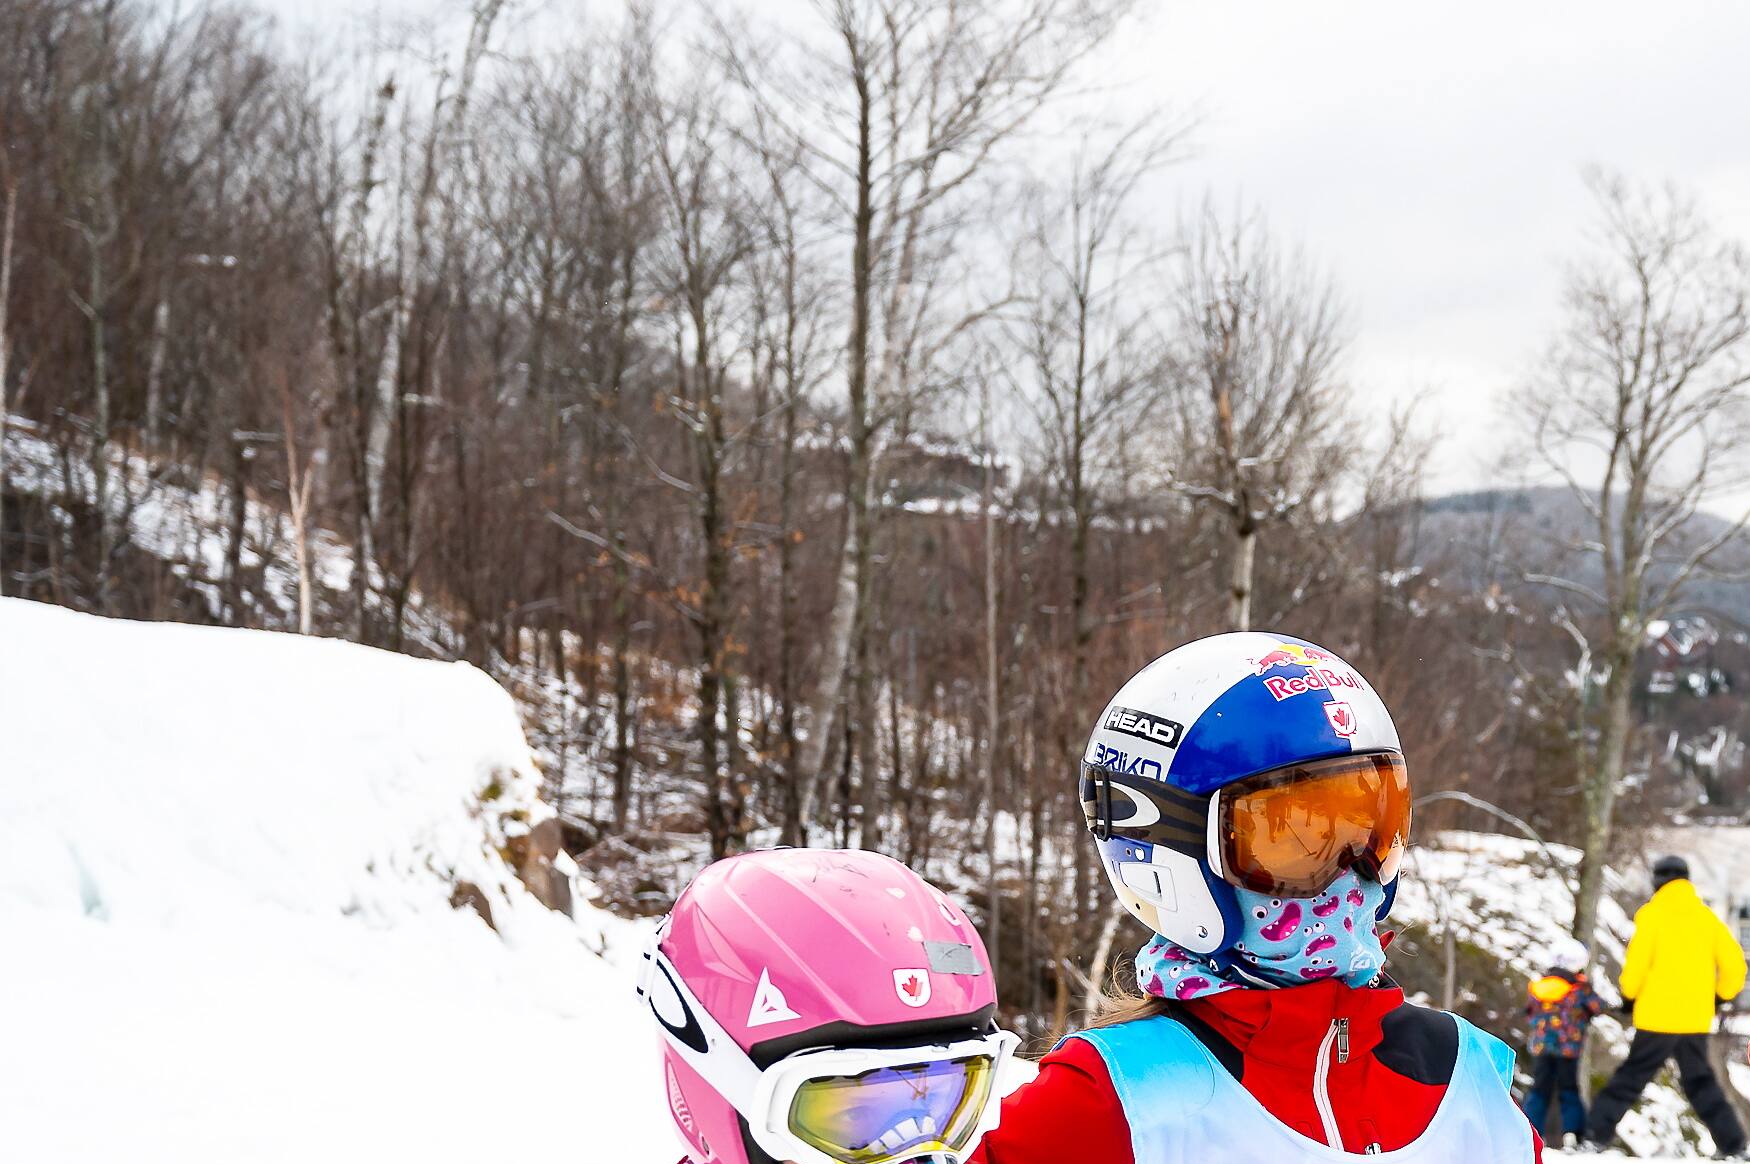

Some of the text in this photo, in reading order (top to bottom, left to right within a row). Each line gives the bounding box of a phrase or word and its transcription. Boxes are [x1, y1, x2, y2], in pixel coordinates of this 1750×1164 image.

[1266, 668, 1365, 700] Red Bull
[1105, 710, 1175, 743] HEAD
